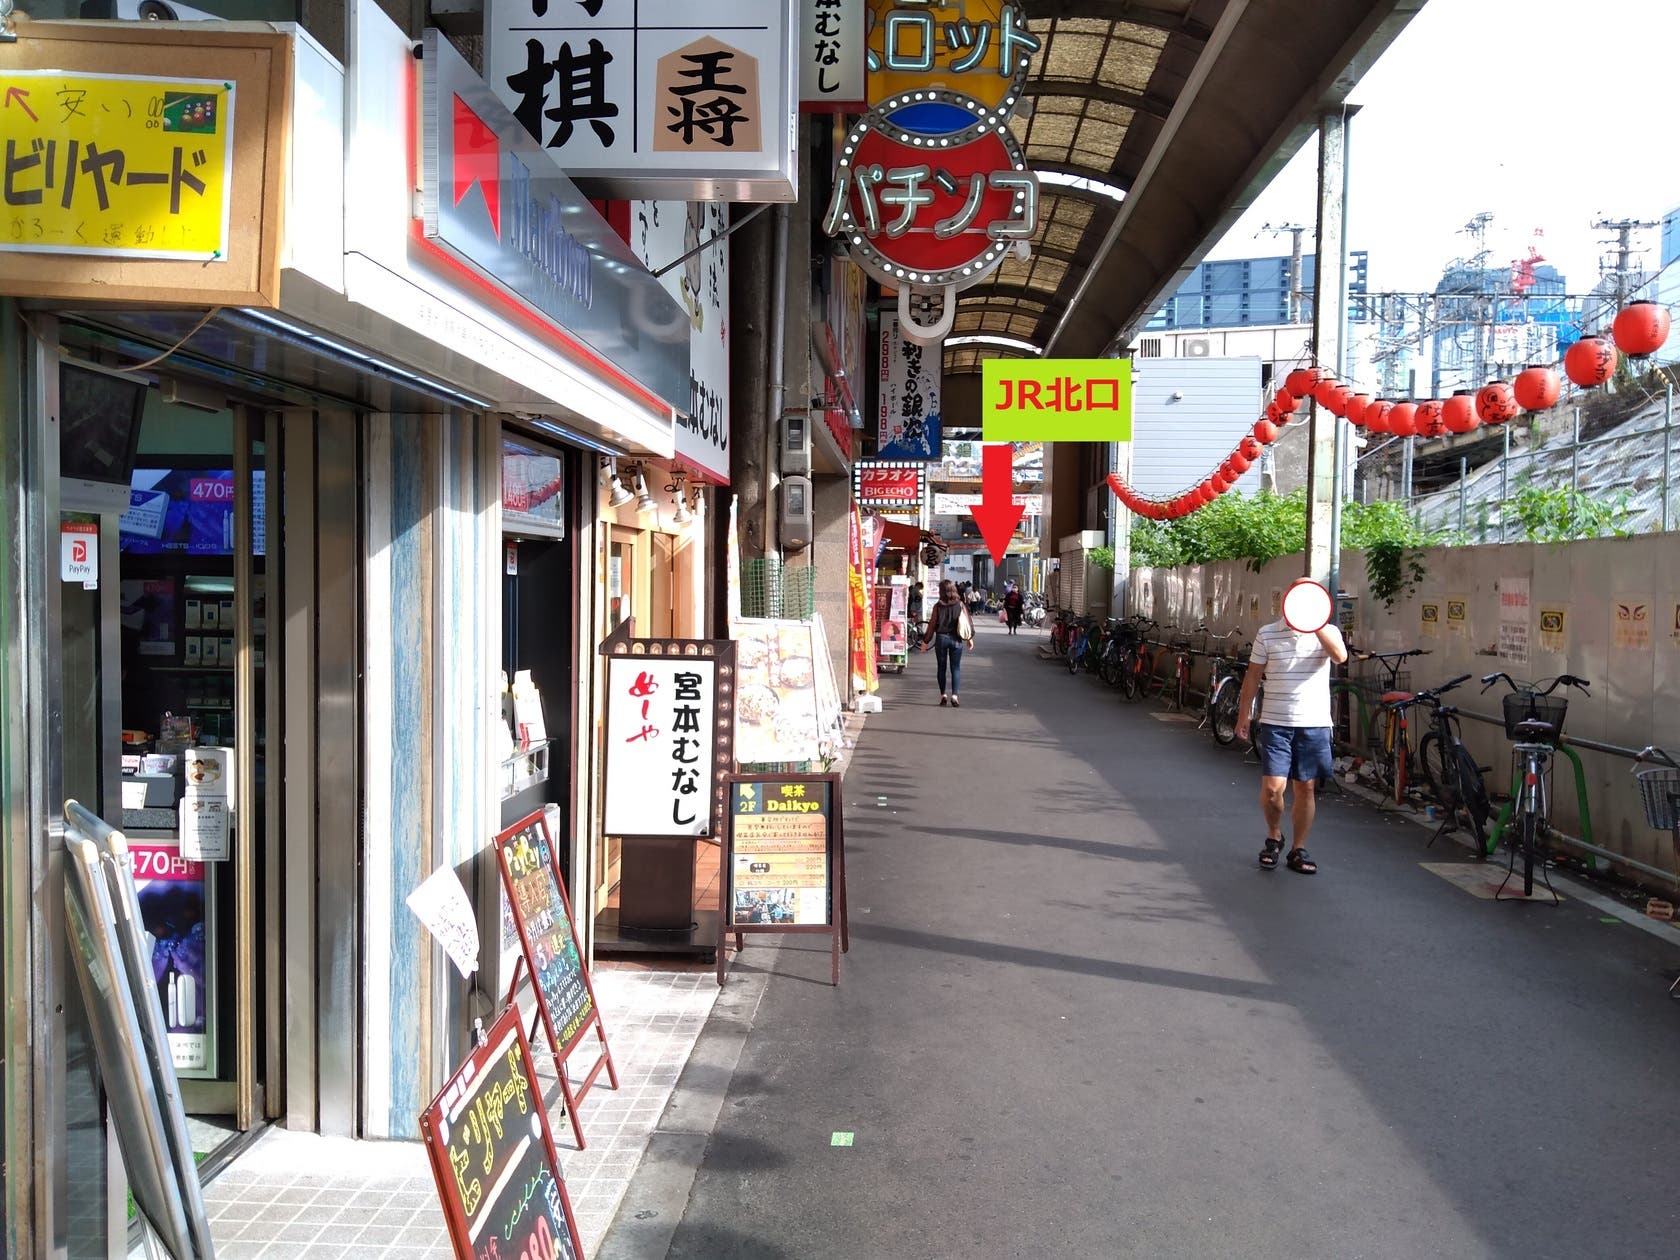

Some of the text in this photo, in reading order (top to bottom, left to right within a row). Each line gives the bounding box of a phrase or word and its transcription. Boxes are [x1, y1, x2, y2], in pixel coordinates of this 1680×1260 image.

[866, 4, 1043, 78] ロット
[667, 50, 750, 147] 王将
[3, 137, 207, 215] ビリヤード
[822, 163, 1041, 241] パチンコ
[675, 368, 728, 452] 本むなし
[862, 469, 918, 482] カラオケ
[864, 486, 914, 497] BIG ECHO
[68, 562, 91, 576] PayPay
[671, 671, 703, 826] 宮本むなし
[739, 801, 756, 813] 2F
[767, 799, 820, 814] Daikyo
[780, 784, 806, 799] 喫茶
[449, 1043, 528, 1217] ビリヤード
